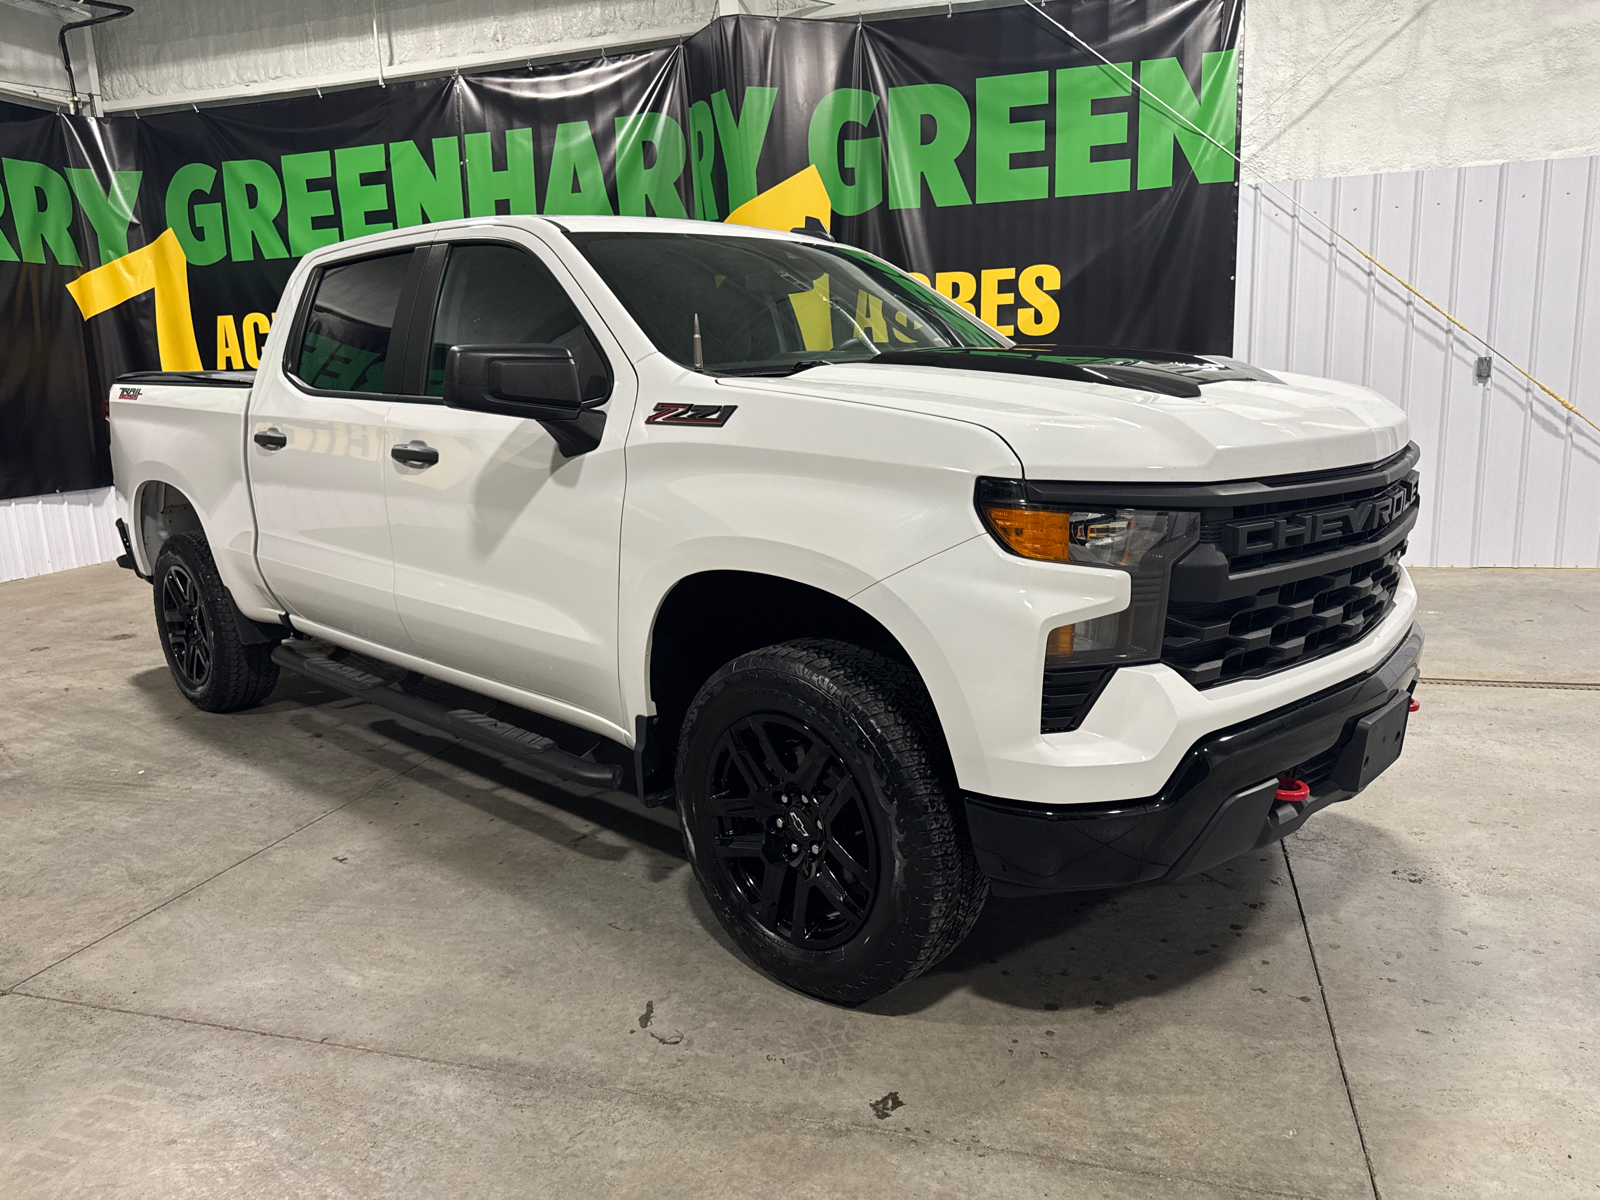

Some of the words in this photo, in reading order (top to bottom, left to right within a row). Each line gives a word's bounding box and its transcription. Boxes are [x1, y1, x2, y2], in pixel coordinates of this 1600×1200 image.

[808, 49, 1239, 216] GREEN
[0, 157, 143, 268] RY
[165, 135, 460, 266] GREEN
[66, 227, 204, 372] 7
[119, 387, 143, 396] TRAIL
[645, 402, 739, 428] Z71
